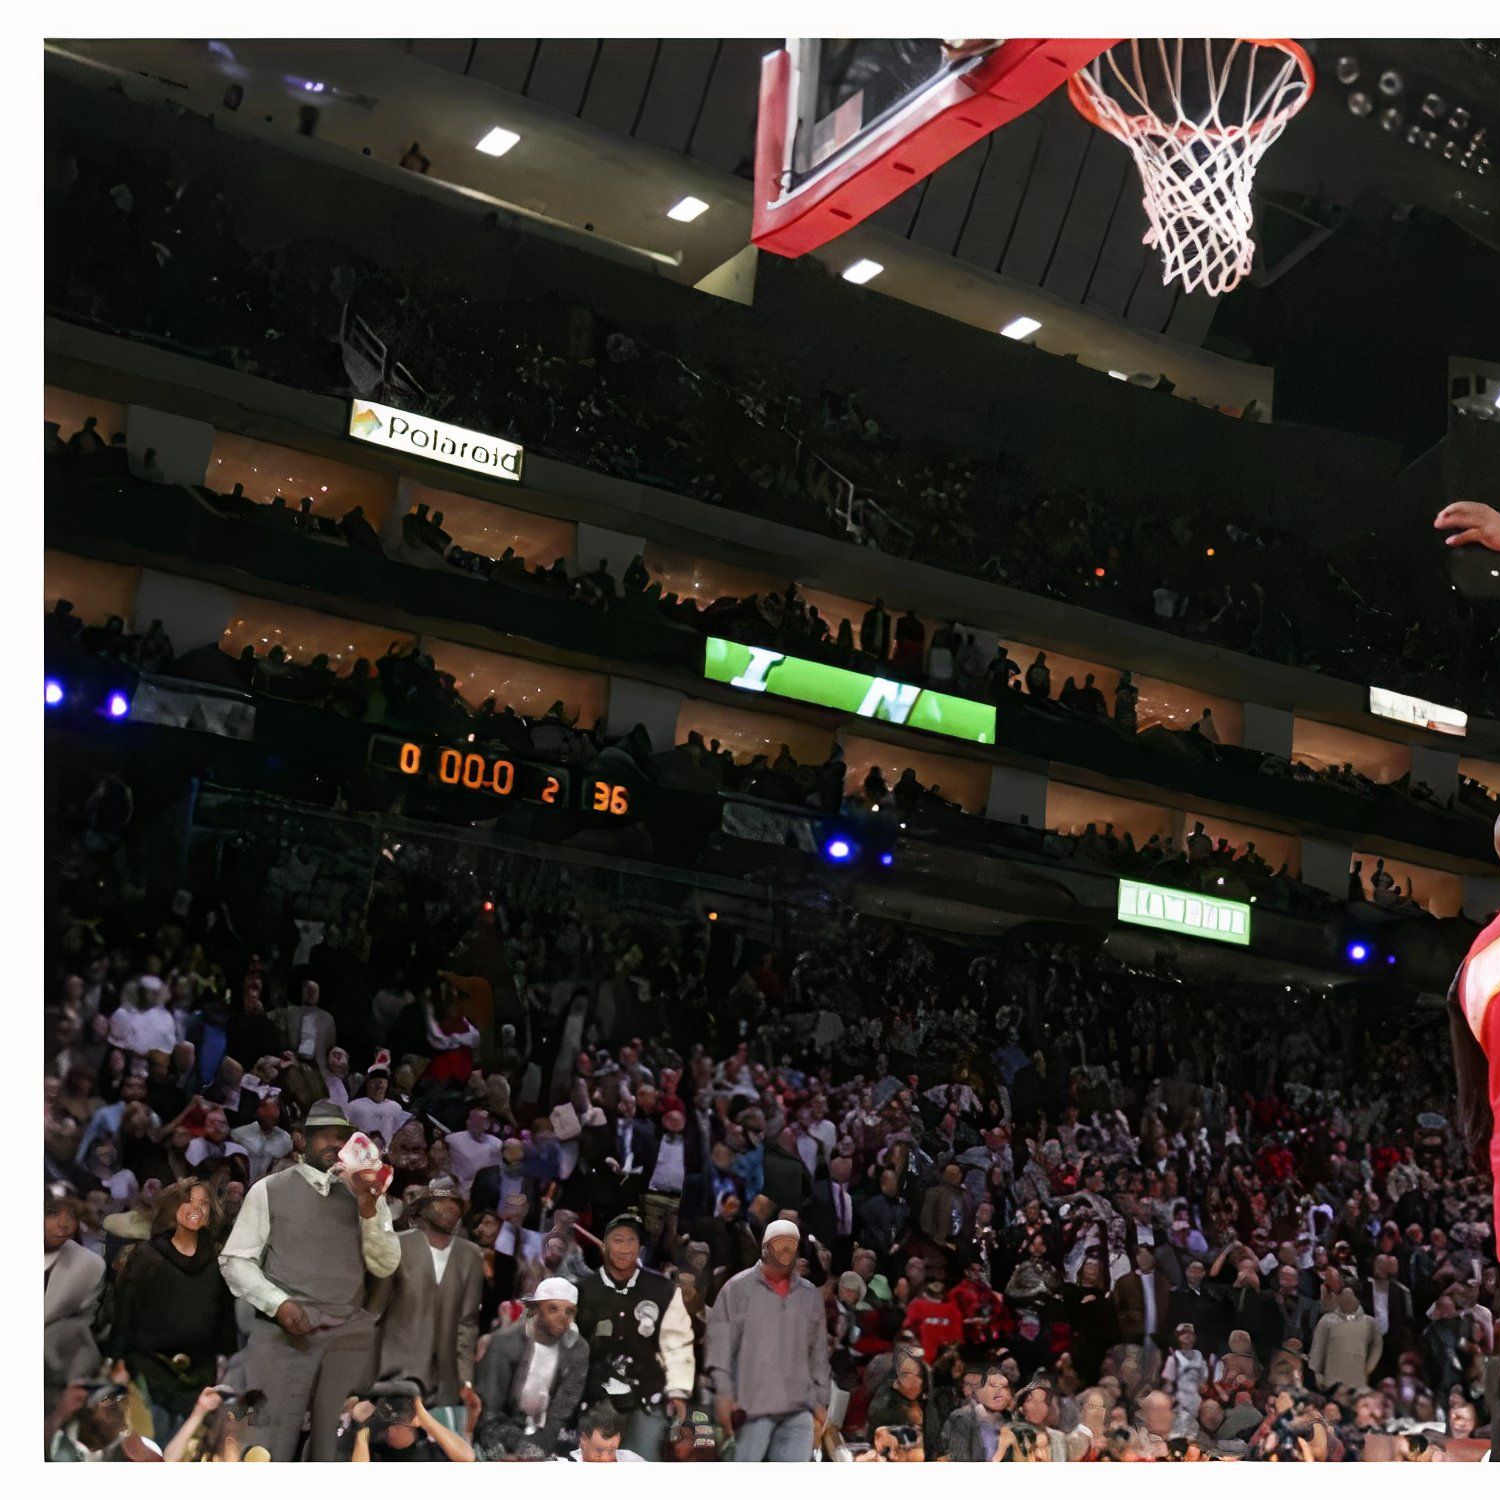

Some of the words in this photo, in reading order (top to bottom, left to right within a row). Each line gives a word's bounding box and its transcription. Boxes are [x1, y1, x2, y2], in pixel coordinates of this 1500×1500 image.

[389, 416, 521, 475] Polaroid
[400, 742, 421, 774] 0
[541, 776, 560, 803] 2
[593, 781, 629, 815] 36
